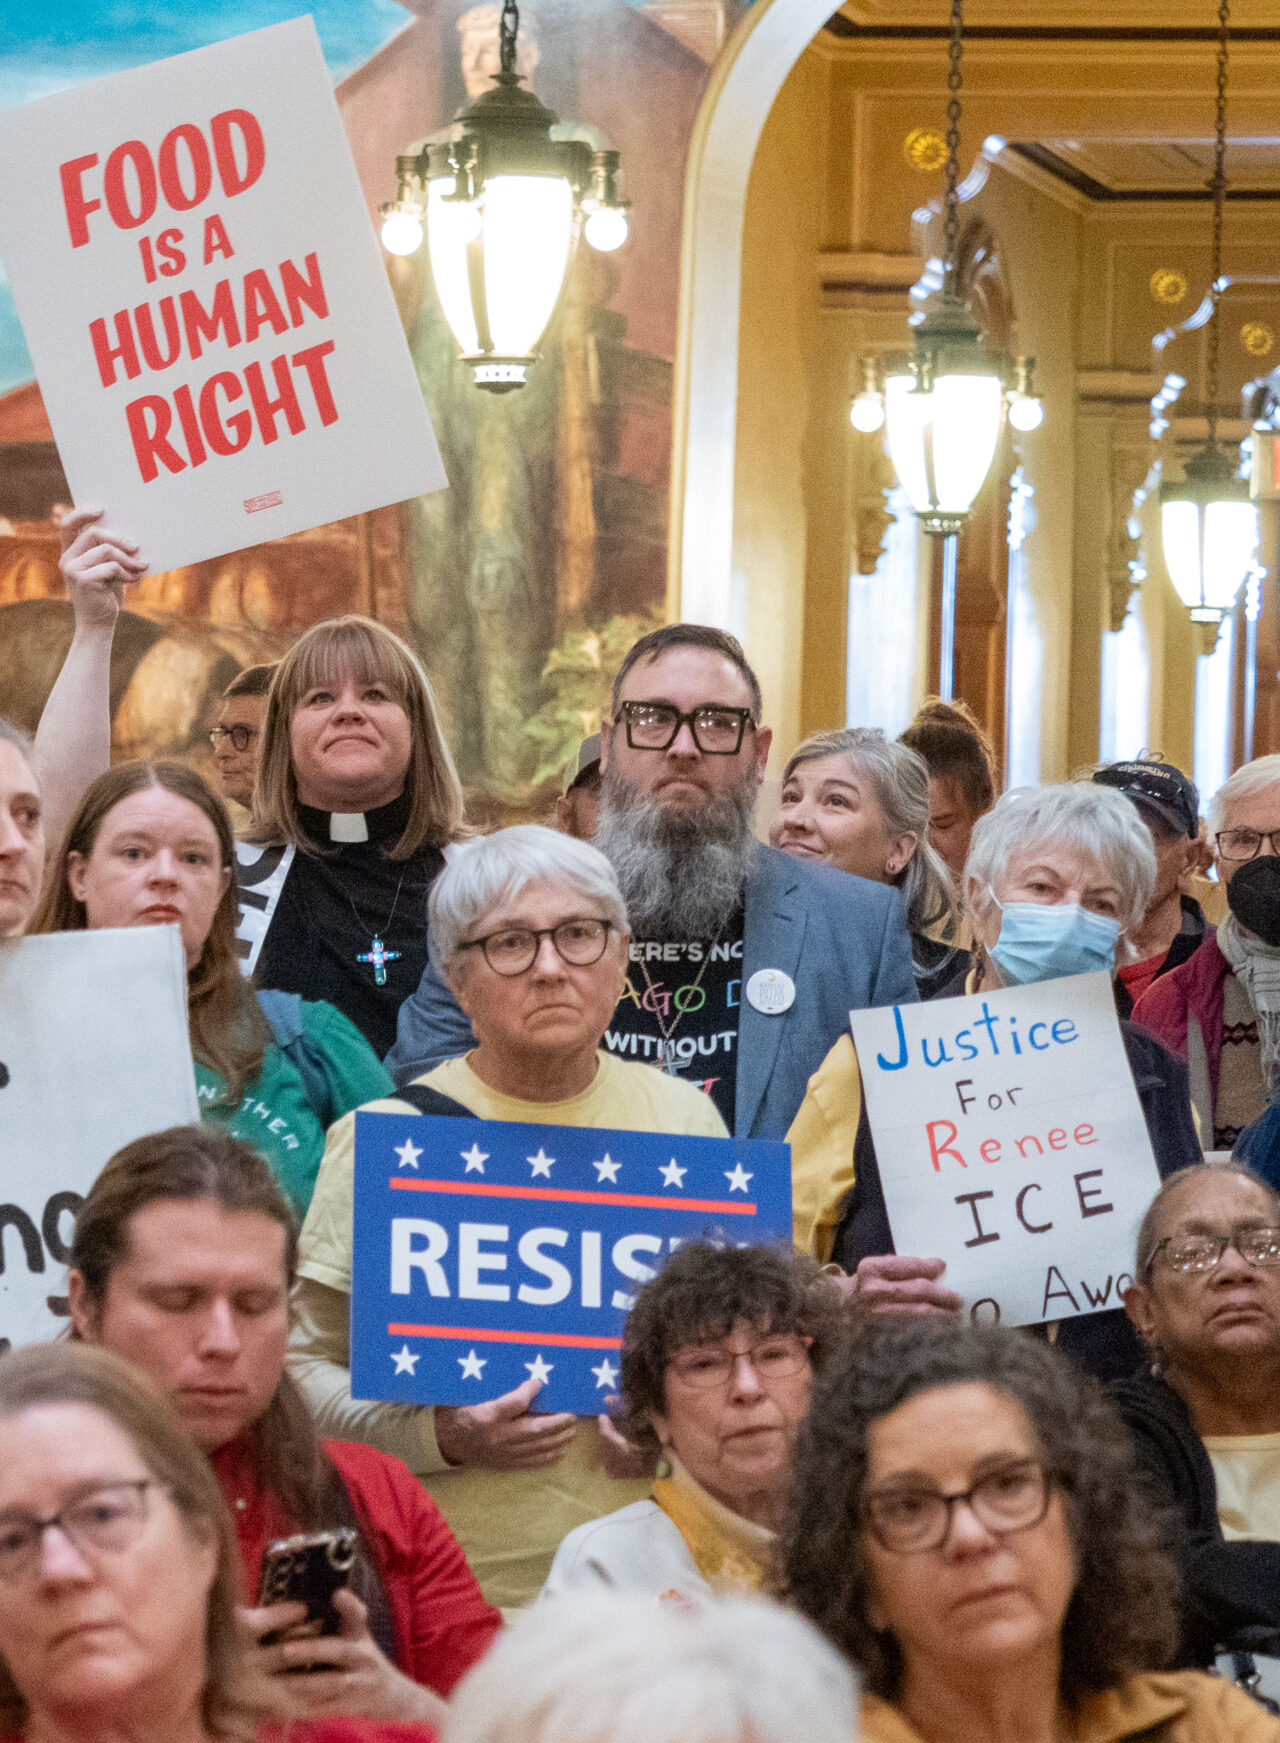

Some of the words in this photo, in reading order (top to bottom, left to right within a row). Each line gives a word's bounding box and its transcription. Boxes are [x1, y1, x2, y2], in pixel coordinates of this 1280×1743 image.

[59, 108, 266, 249] FOOD
[138, 228, 187, 284] IS
[202, 213, 235, 266] A
[89, 252, 330, 388] HUMAN
[126, 339, 339, 484] RIGHT
[604, 1031, 737, 1061] WITHOUT
[877, 1003, 1079, 1071] Justice
[955, 1078, 1023, 1115] For
[925, 1119, 1100, 1172] Renee
[954, 1169, 1114, 1248] ICE
[390, 1217, 685, 1312] RESIS
